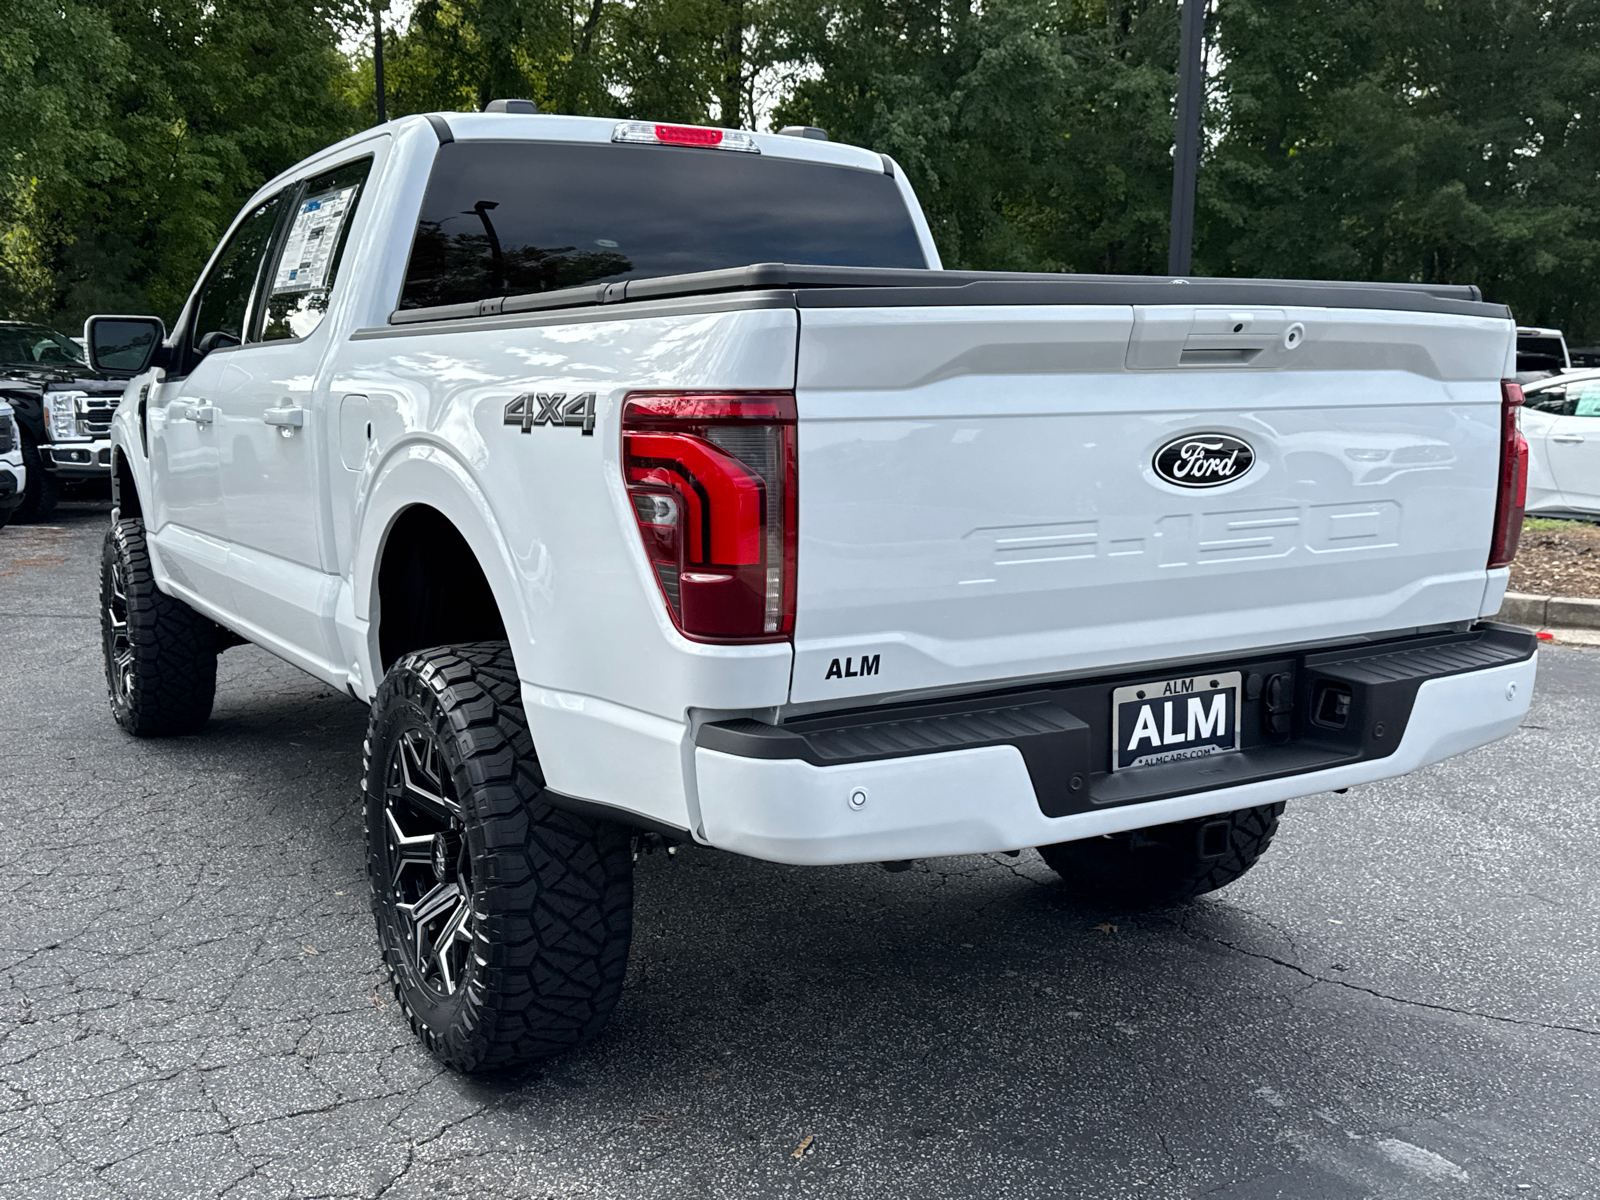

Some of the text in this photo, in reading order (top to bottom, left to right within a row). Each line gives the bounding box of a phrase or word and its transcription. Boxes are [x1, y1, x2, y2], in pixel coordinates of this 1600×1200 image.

[1173, 441, 1239, 478] Ford
[958, 499, 1403, 585] F-150
[824, 654, 881, 680] ALM
[1163, 678, 1194, 695] ALM
[1126, 693, 1226, 751] ALM
[1144, 749, 1211, 767] ALMCARS.COM
